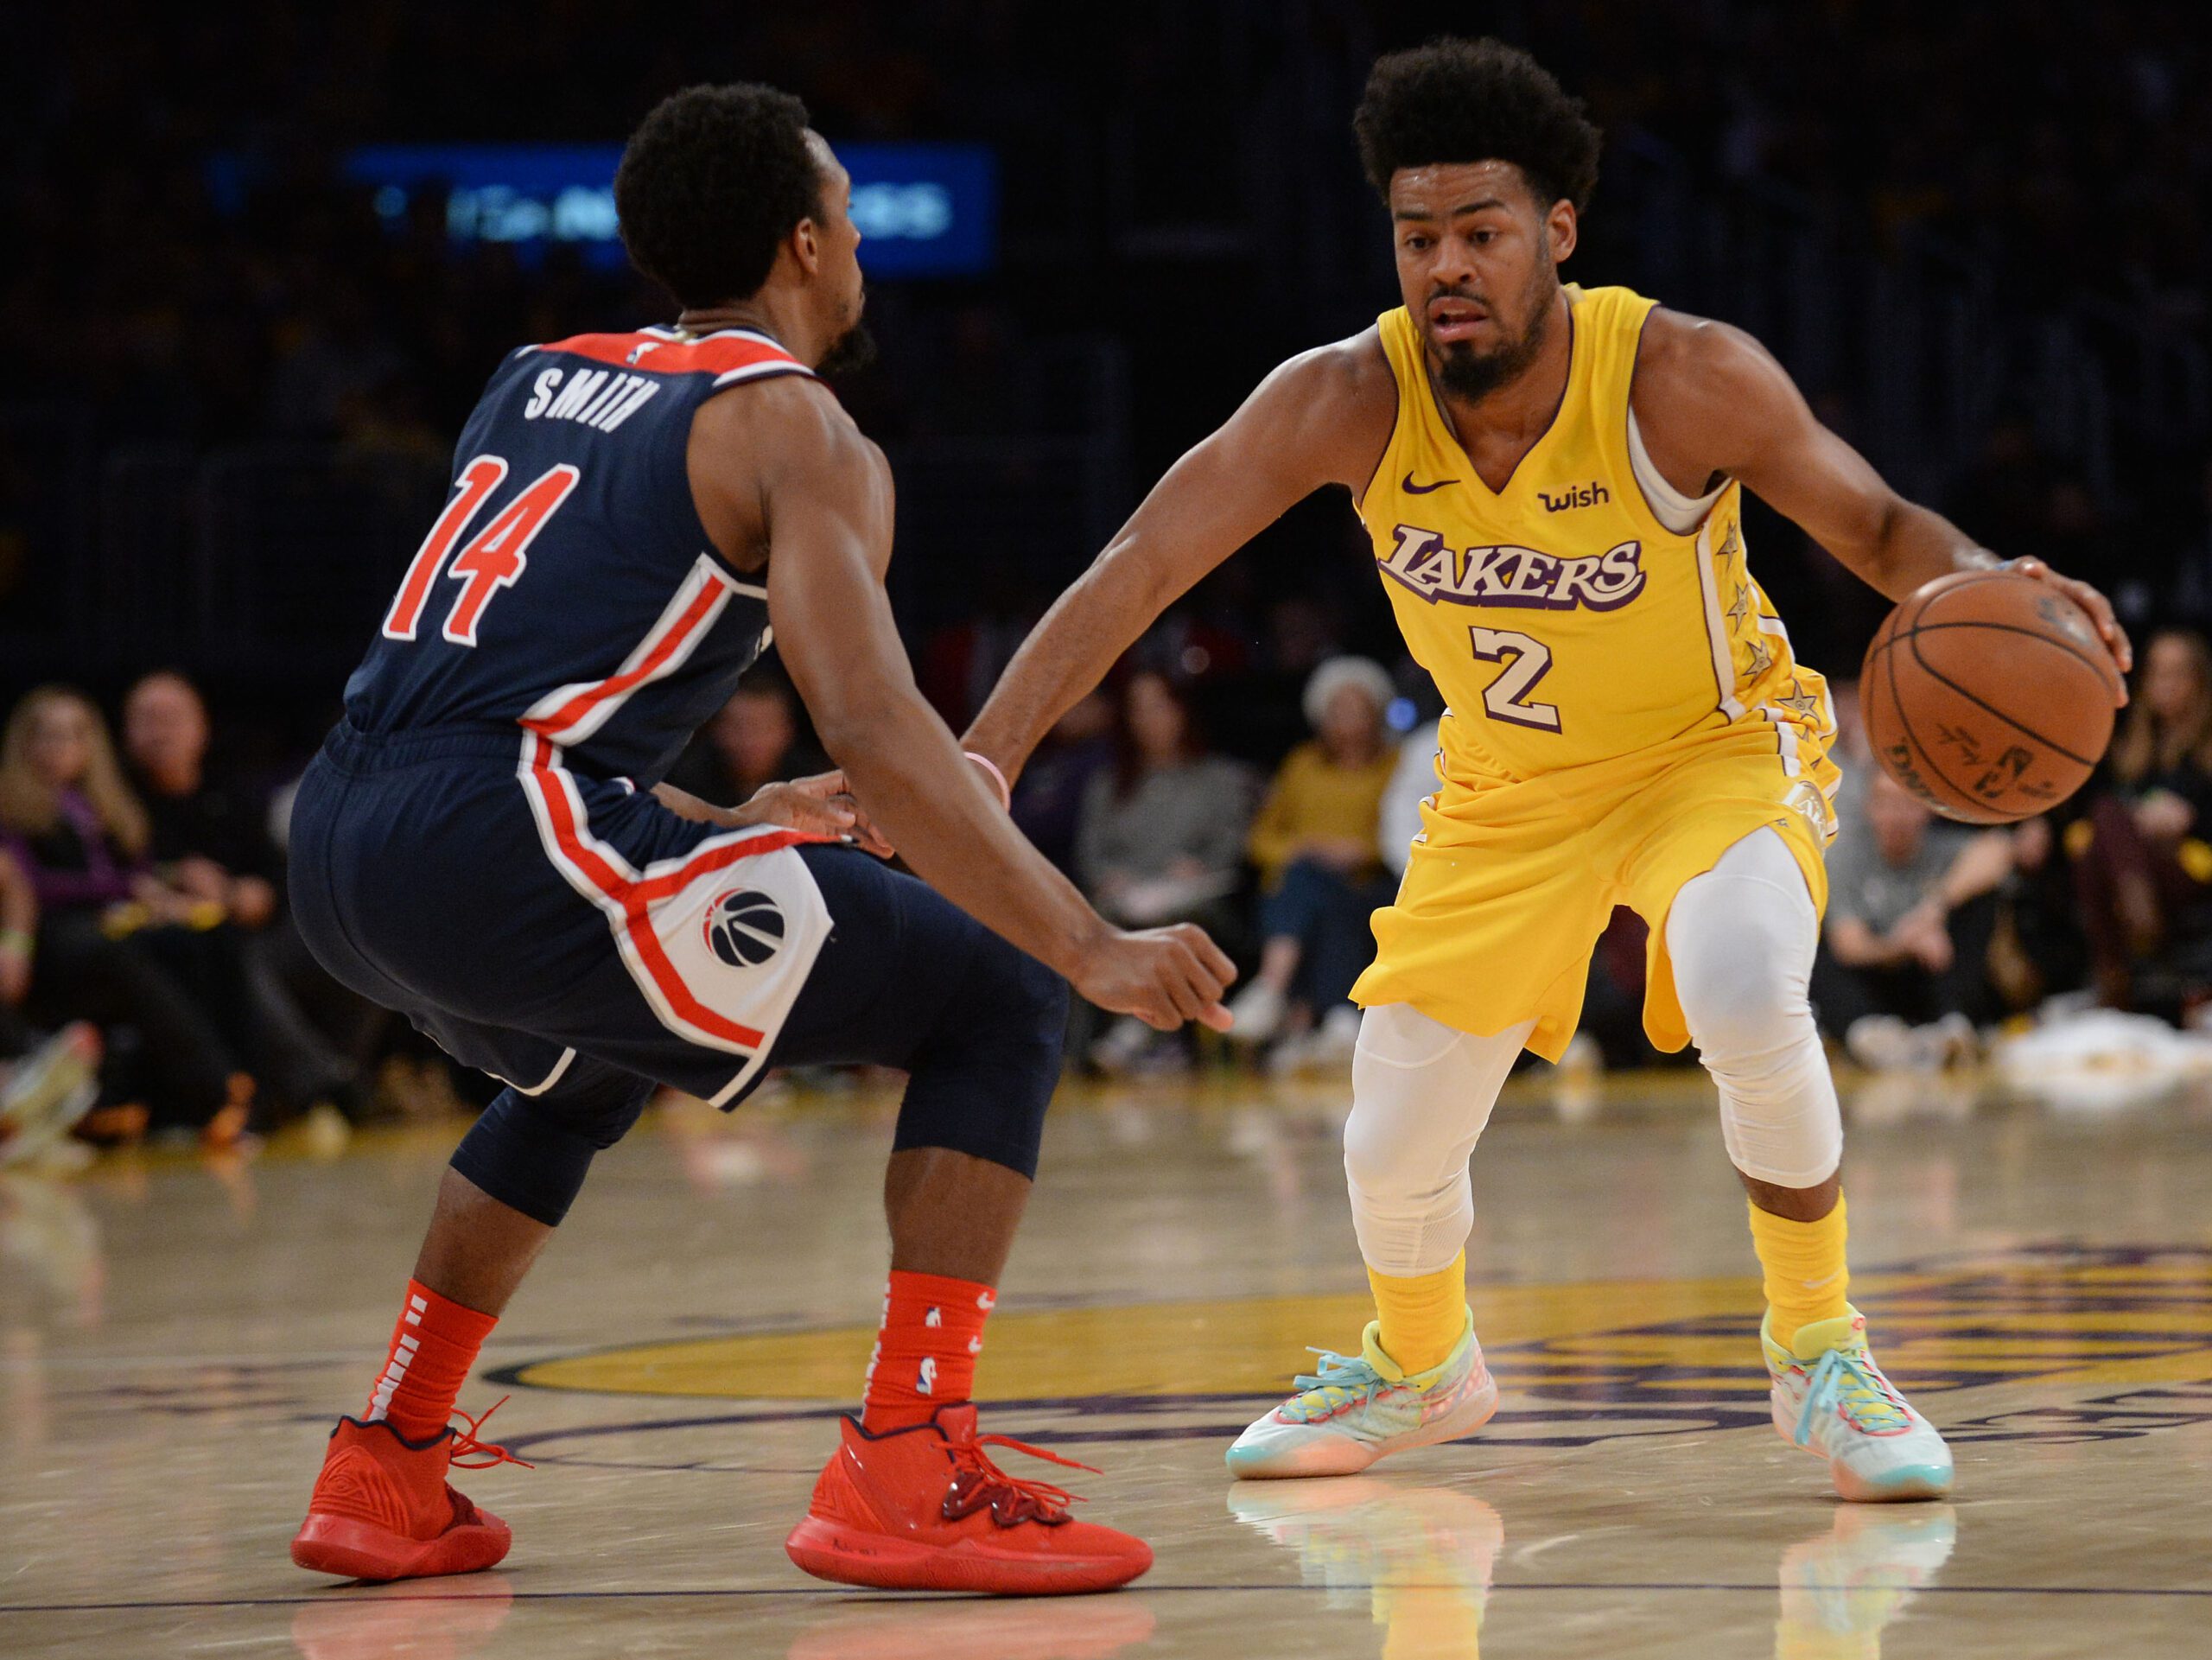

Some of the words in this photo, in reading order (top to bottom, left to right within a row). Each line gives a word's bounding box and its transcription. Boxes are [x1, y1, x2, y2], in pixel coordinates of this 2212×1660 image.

[524, 368, 660, 432] SMITH
[1537, 481, 1609, 512] wish
[383, 455, 580, 646] 14
[1378, 524, 1646, 612] LAKERS
[1468, 626, 1562, 735] 2
